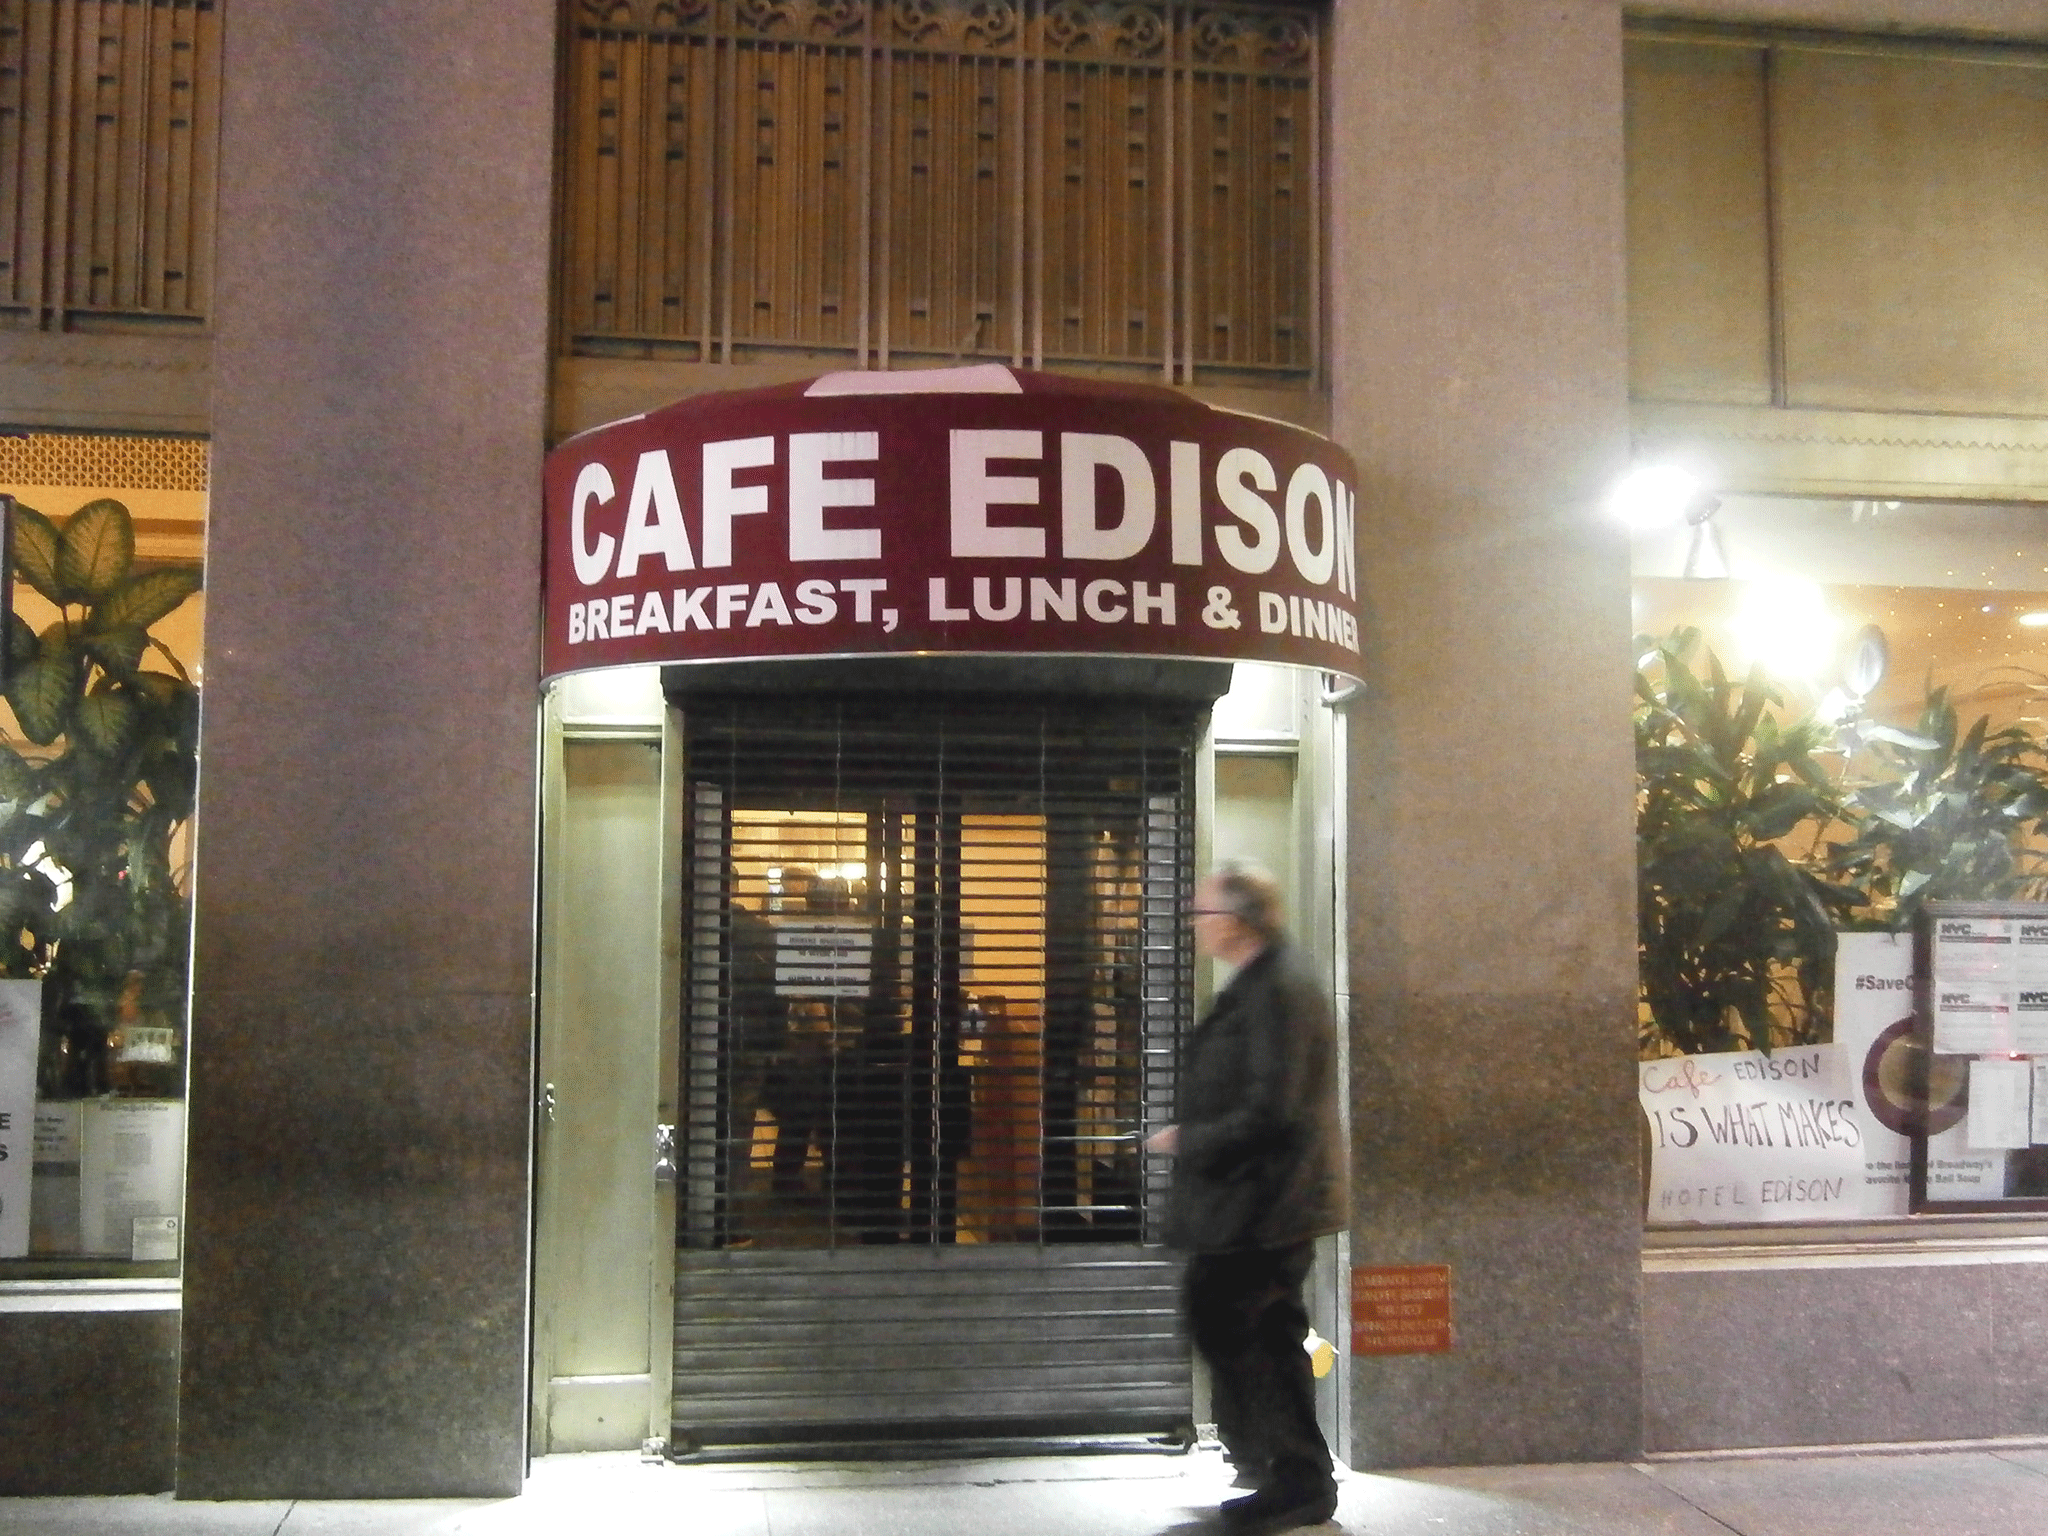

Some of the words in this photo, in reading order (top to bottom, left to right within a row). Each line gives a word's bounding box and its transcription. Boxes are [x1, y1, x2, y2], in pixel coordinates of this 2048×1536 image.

[570, 430, 882, 586] CAFE
[950, 428, 1357, 602] EDISON
[568, 577, 900, 644] BREAKFAST,
[929, 577, 1176, 628] LUNCH
[1202, 585, 1240, 630] &
[1941, 923, 1972, 935] NYC
[1941, 993, 1971, 1004] NYC
[1733, 1053, 1820, 1081] EDISON
[1654, 1106, 1699, 1149] IS
[1700, 1102, 1774, 1148] WHAT
[1777, 1099, 1861, 1150] MAKES
[1661, 1185, 1745, 1210] HOTEL
[1761, 1176, 1844, 1204] EDISON
